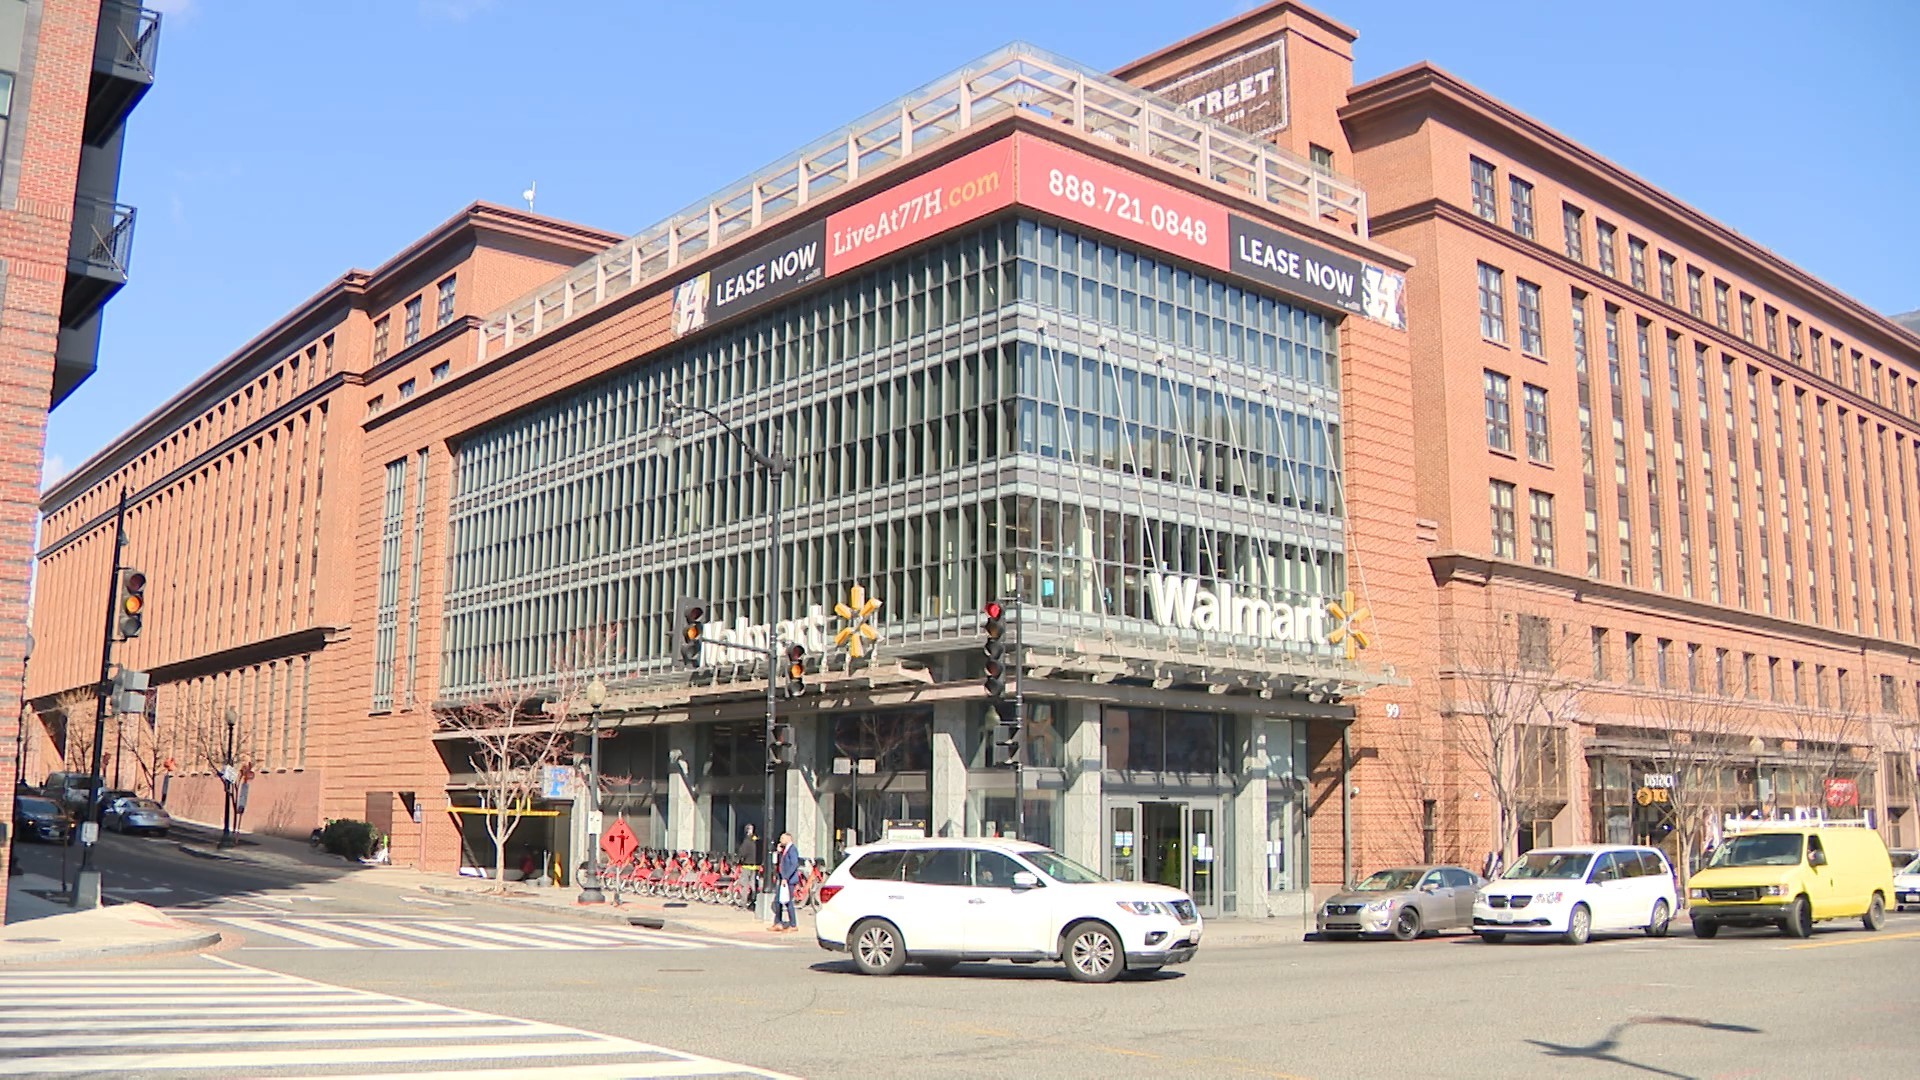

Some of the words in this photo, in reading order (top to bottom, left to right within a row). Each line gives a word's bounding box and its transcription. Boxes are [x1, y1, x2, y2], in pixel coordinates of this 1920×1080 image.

[832, 170, 1000, 257] LiveAt77H.com
[1049, 168, 1208, 246] 888.721.0848
[716, 263, 766, 307] LEASE
[770, 241, 818, 284] NOW
[1239, 234, 1301, 280] LEASE
[1306, 259, 1354, 298] NOW
[1147, 573, 1326, 645] Walmart
[1385, 703, 1400, 718] 99
